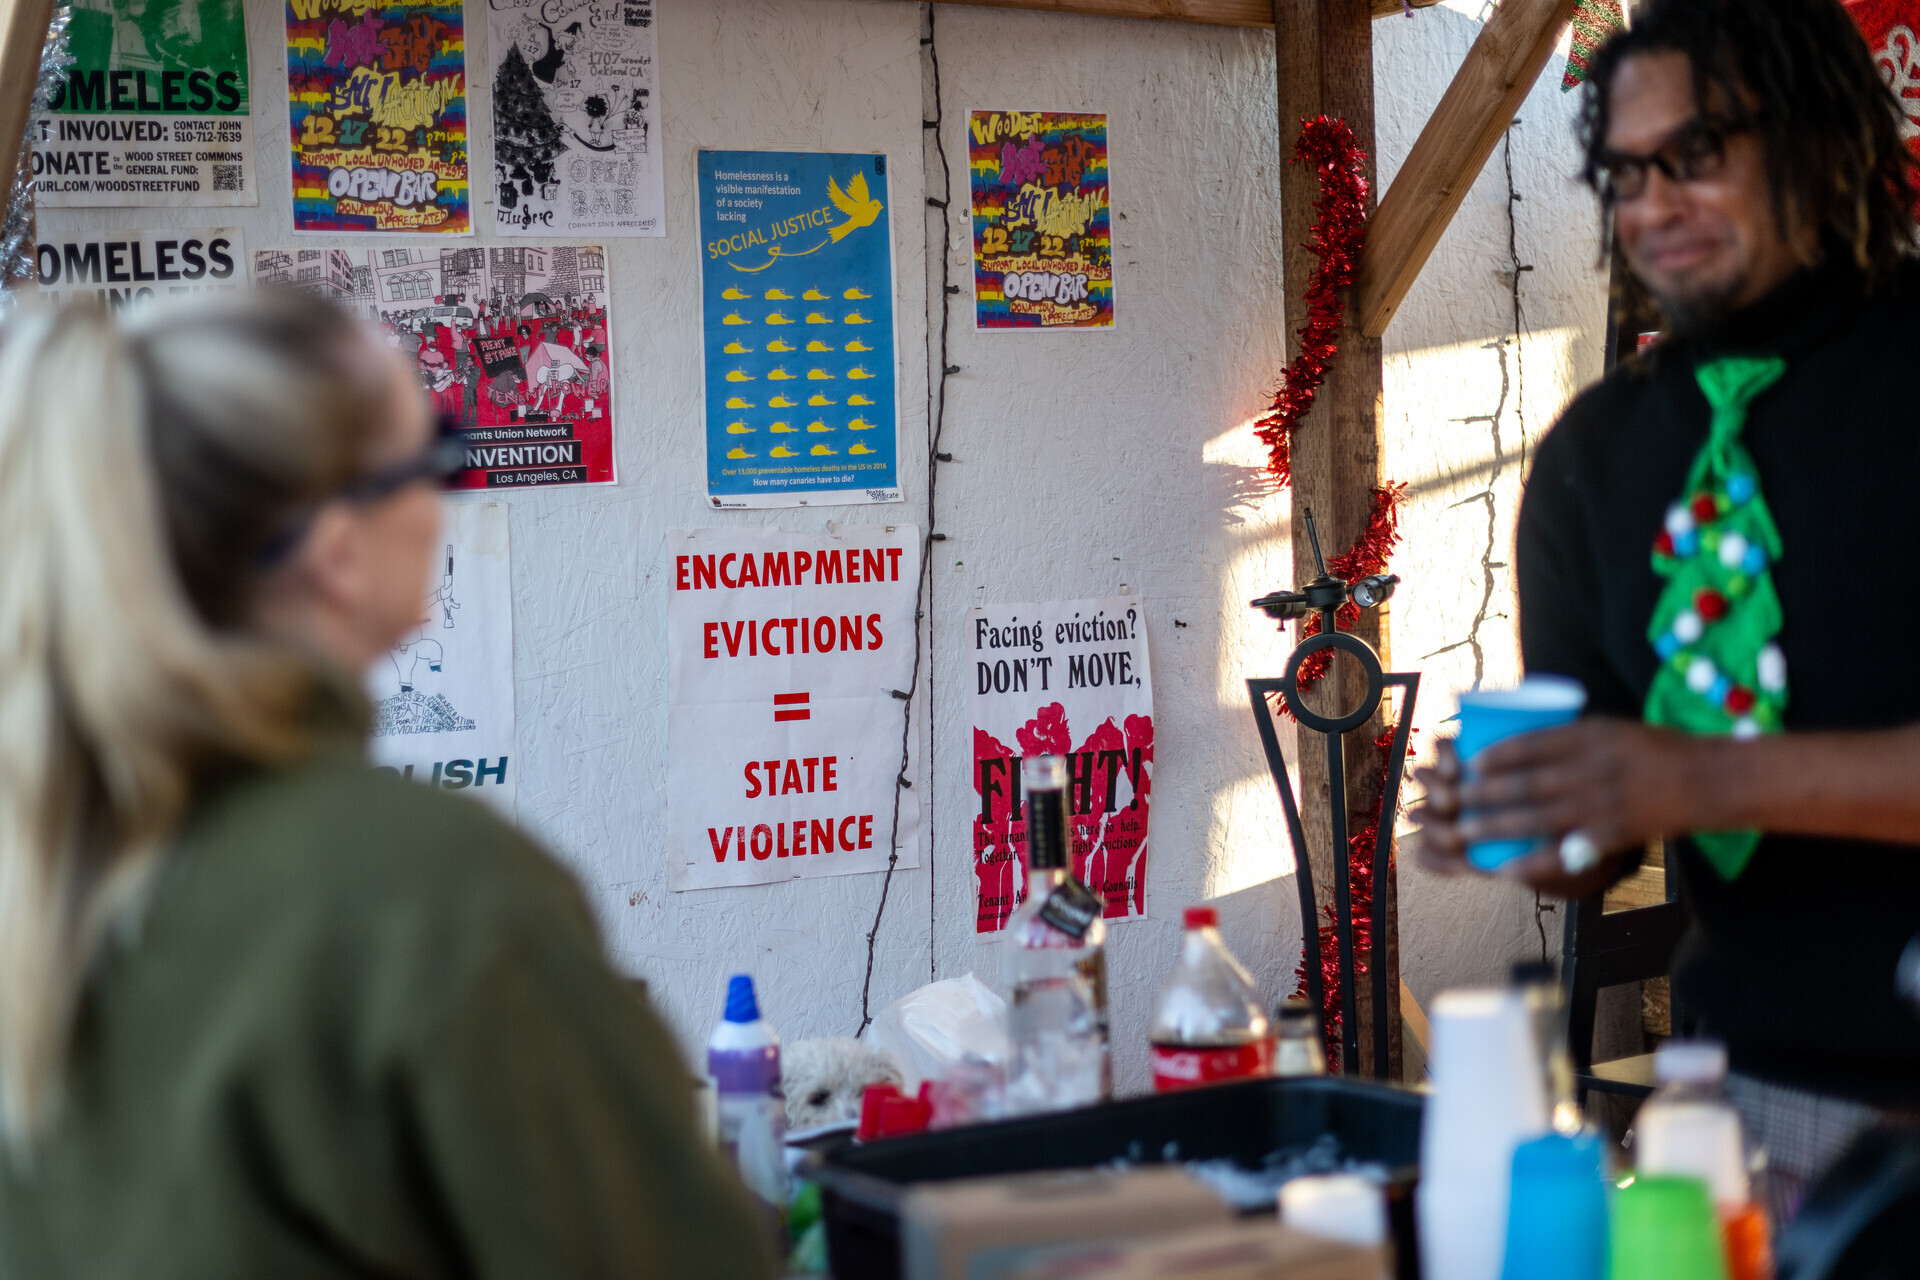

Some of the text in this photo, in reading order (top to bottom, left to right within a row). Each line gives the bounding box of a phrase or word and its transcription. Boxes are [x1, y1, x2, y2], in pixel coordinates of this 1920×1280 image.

[588, 52, 621, 65] 1707
[590, 66, 643, 77] Oakland CA
[570, 80, 581, 89] 17
[59, 120, 169, 141] INVOLVED:
[173, 121, 242, 130] CONTACT JOHN
[174, 131, 242, 142] 510-712-7639
[125, 152, 243, 161] WOOD STREET COMMONS
[126, 165, 199, 175] GENERAL FUND:
[301, 152, 467, 179] SUPPORT LOCAL UNHOUSED ARTISTS
[570, 159, 638, 186] OPEN
[715, 170, 789, 182] Homelessness is a
[329, 167, 437, 206] OPEN BAR
[716, 185, 801, 195] visible manifestation
[337, 202, 394, 216] DONATIONS
[571, 190, 633, 216] BAR
[716, 198, 763, 210] of a society
[377, 209, 448, 226] APPRECIATED
[717, 212, 747, 223] lacking
[708, 206, 833, 259] SOCIAL JUSTICE
[982, 259, 1112, 279] SUPPORT LOCAL UNHOUSED ARTISTS
[1003, 272, 1089, 304] OPEN BAR
[1011, 302, 1055, 314] DONATIONS
[1042, 306, 1096, 323] APPRECIATED
[480, 339, 506, 351] RENT
[484, 346, 517, 364] STRIKE
[551, 379, 608, 398] POWER
[495, 429, 524, 439] Union
[526, 427, 567, 438] Network
[496, 470, 578, 485] Los Angeles, CA
[722, 468, 736, 476] Over
[739, 467, 757, 475] 13,000
[758, 467, 793, 475] preventable
[794, 465, 820, 473] homeless
[821, 464, 840, 472] deaths
[848, 463, 857, 471] the
[769, 479, 788, 487] many
[789, 477, 816, 485] canaries
[816, 476, 832, 484] have
[676, 548, 903, 591] ENCAMPMENT
[704, 613, 883, 659] EVICTIONS
[975, 608, 1137, 653] Facing eviction?
[977, 651, 1141, 695] DON'T MOVE,
[413, 693, 427, 703] SEX
[397, 725, 433, 734] VIOLENCE
[744, 756, 838, 799] STATE
[979, 747, 1142, 825] FIHT!
[708, 815, 874, 863] VIOLENCE
[977, 818, 1141, 846] The tenant is here to help.
[978, 837, 1140, 865] Together, fight evictions.
[977, 893, 1010, 908] Tenant
[1103, 876, 1138, 893] Councils
